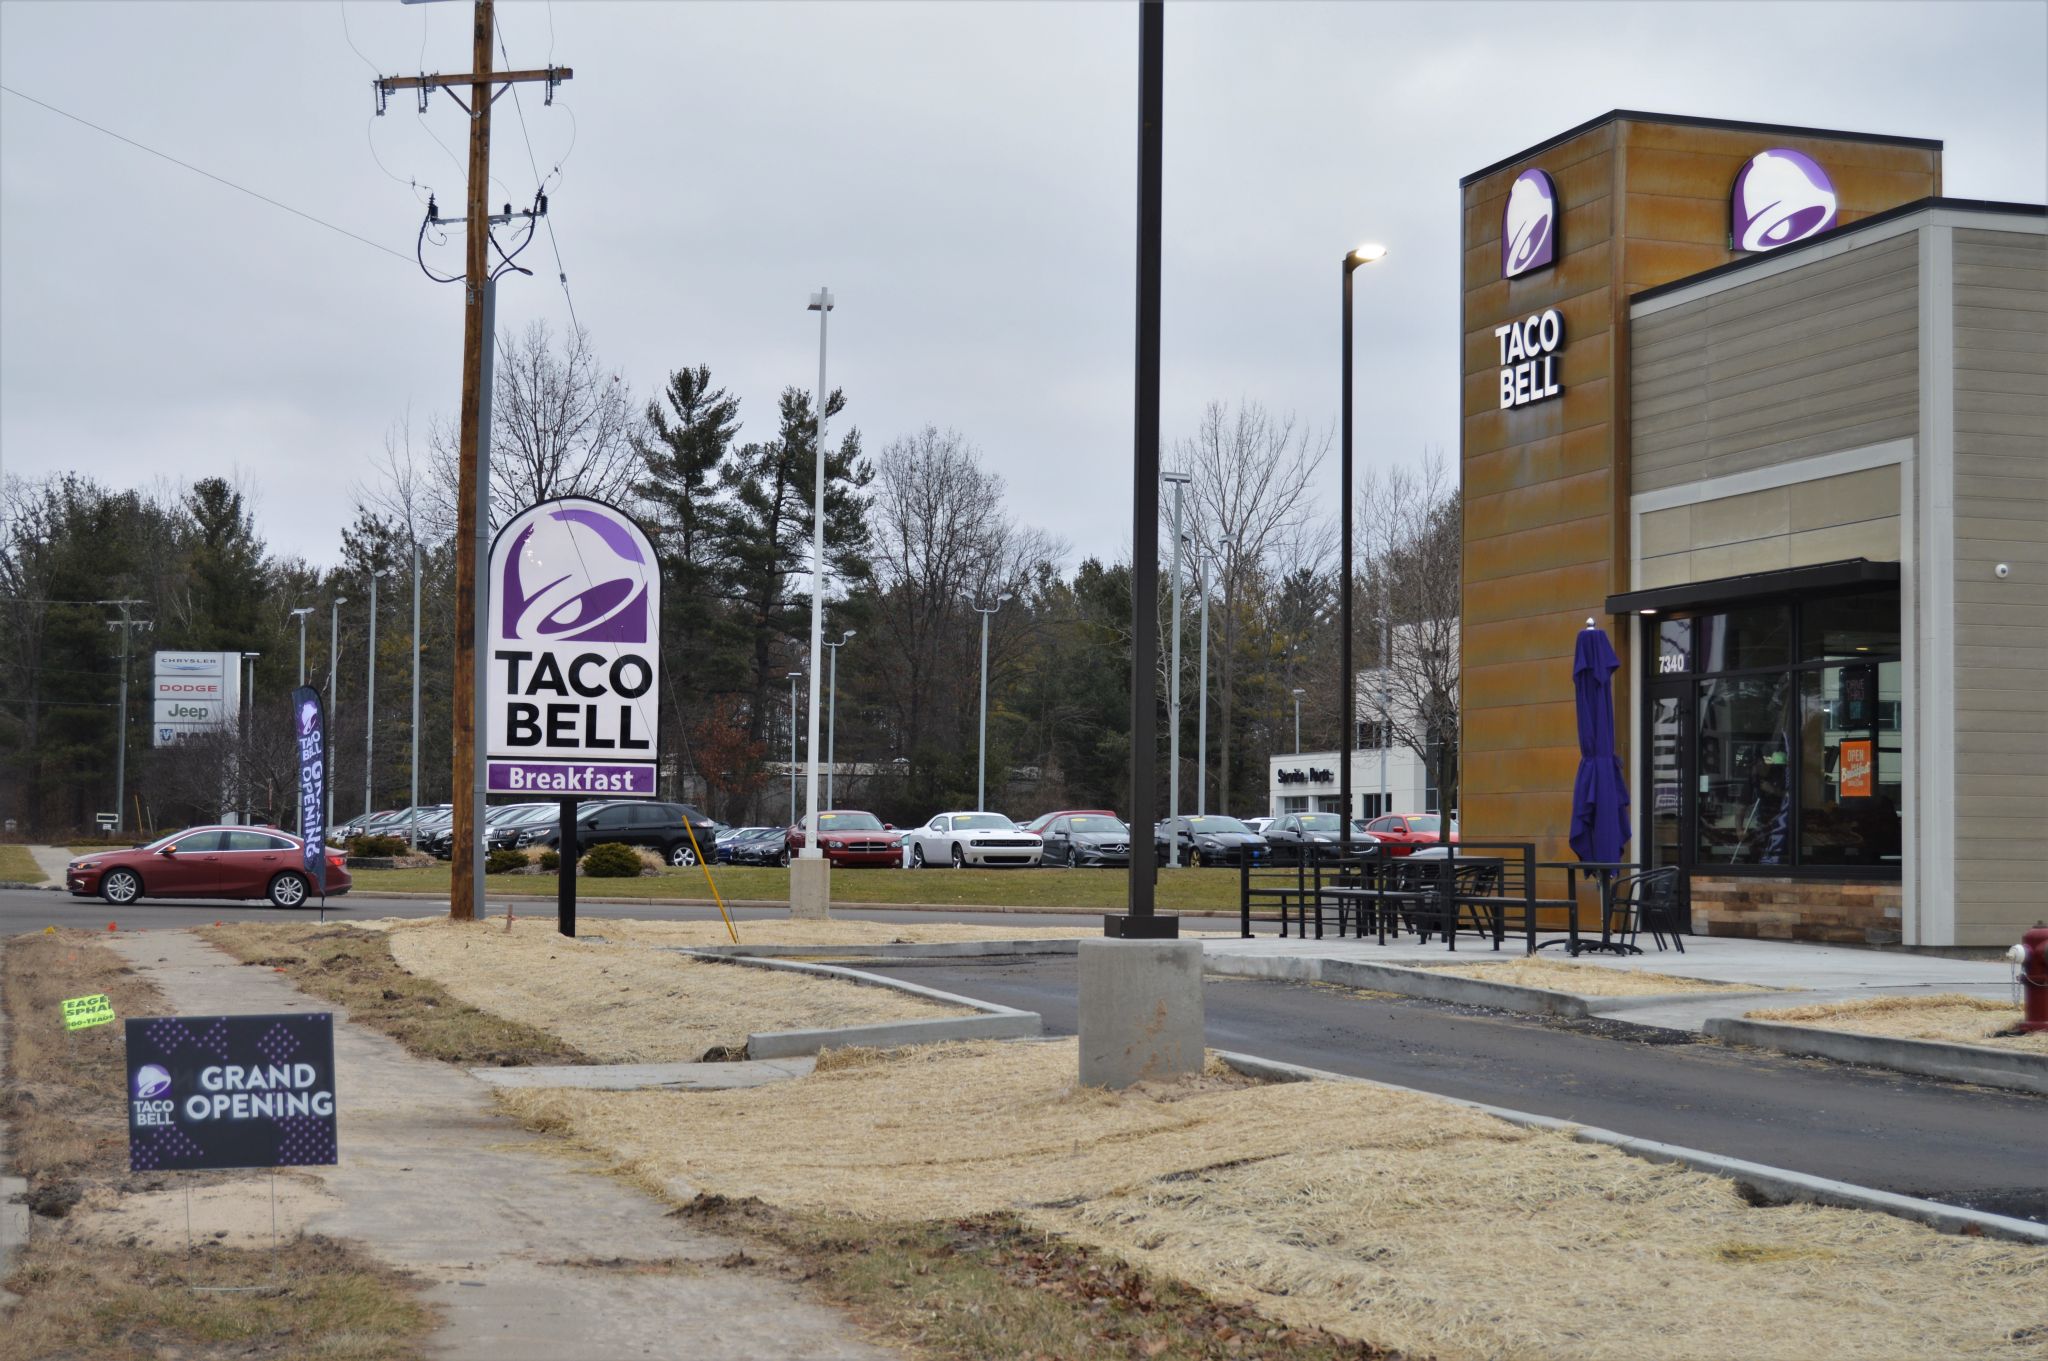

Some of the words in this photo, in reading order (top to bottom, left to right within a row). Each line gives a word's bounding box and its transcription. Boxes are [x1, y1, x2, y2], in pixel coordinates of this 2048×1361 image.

[1495, 309, 1560, 366] TACO
[1500, 356, 1559, 410] BELL
[495, 649, 653, 699] TACO
[1658, 654, 1685, 673] 7340
[159, 684, 218, 692] DODGE
[168, 703, 209, 720] Jeep
[506, 702, 650, 750] BELL
[509, 766, 634, 791] Breakfast
[302, 766, 316, 858] OPENING
[201, 1063, 316, 1091] GRAND
[133, 1100, 175, 1113] TACO
[137, 1112, 175, 1126] BELL
[186, 1091, 333, 1120] OPENING
